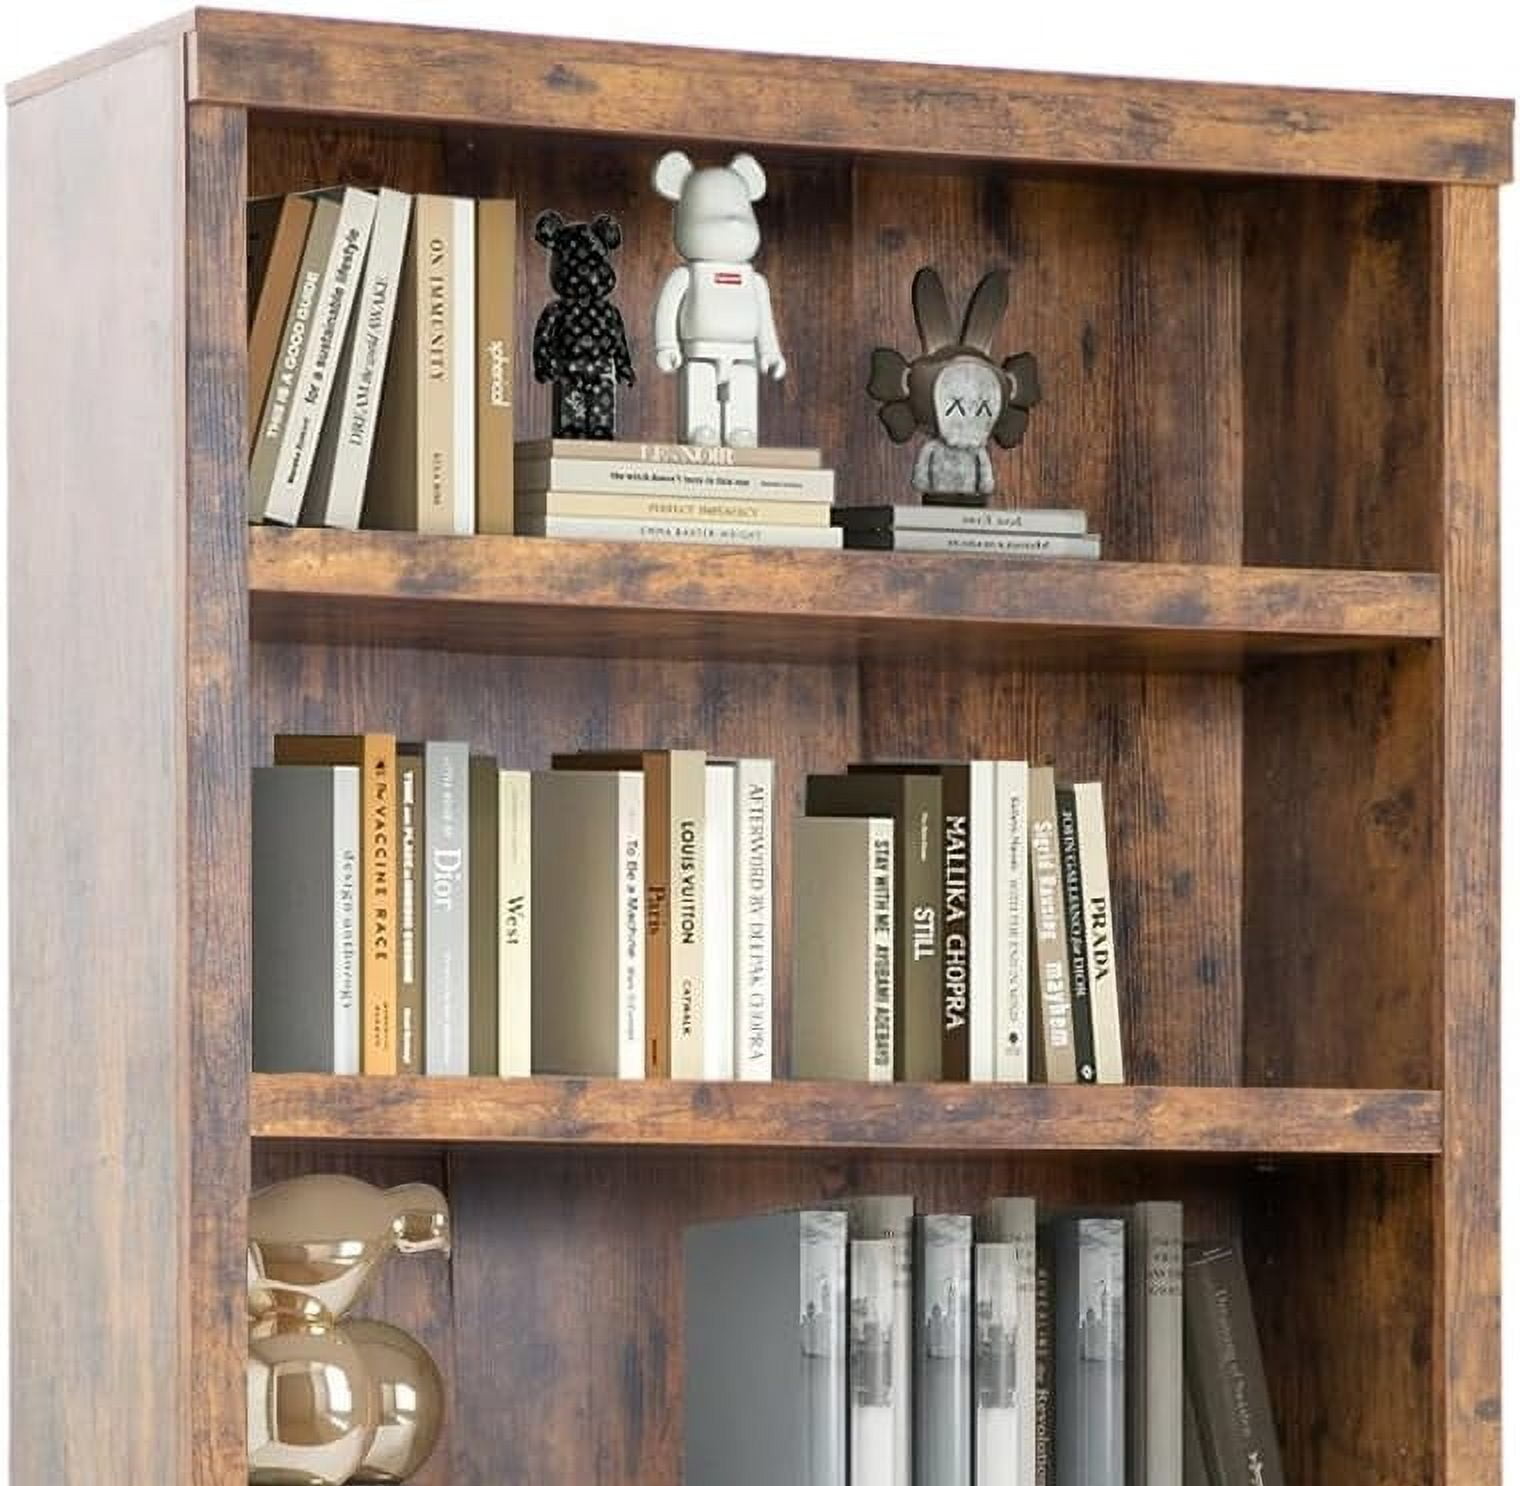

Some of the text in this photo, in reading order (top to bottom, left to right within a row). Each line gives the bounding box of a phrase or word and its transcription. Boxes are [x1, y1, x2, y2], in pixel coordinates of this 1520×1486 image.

[430, 238, 445, 382] ON IMMUNITY
[375, 807, 387, 897] VACCINE
[749, 784, 764, 891] AFTERWORD
[874, 840, 889, 872] STAY
[434, 848, 462, 911] Dior
[681, 821, 695, 945] LOUIS VUITTON
[1062, 812, 1075, 852] JOHN
[1074, 957, 1087, 994] DIOR
[375, 907, 387, 961] RACE
[506, 895, 525, 945] West
[749, 922, 764, 985] DEEPAK
[874, 914, 889, 933] ME
[913, 906, 935, 961] STILL
[946, 815, 967, 1030] MALLIKA CHOPRA
[1089, 898, 1111, 979] PRADA
[749, 992, 764, 1061] CHOPRA
[1044, 961, 1072, 1045] mayhem
